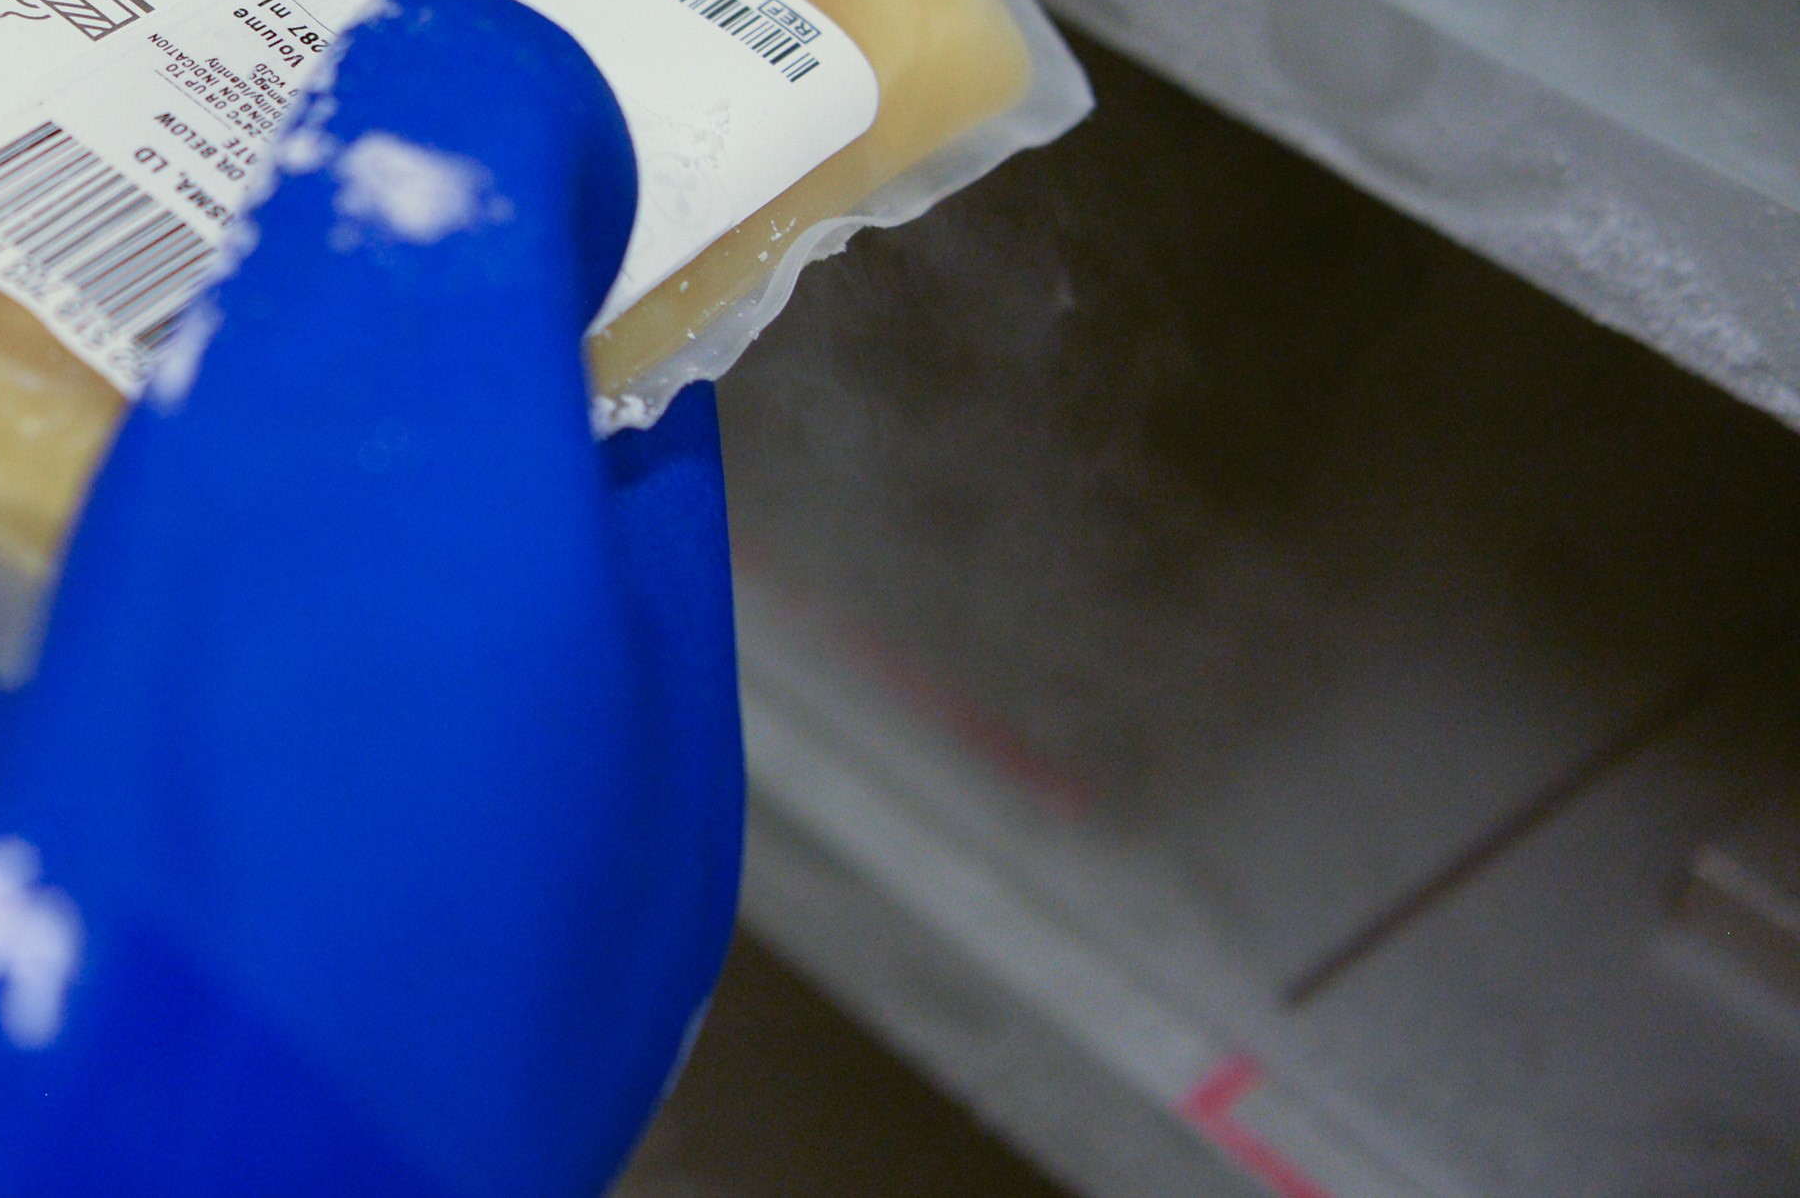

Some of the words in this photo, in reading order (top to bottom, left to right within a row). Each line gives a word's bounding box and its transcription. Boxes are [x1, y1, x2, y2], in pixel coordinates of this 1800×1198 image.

[765, 5, 815, 39] REF
[233, 7, 304, 68] Volume
[288, 25, 331, 53] 287
[148, 33, 220, 87] INDICATION
[166, 63, 185, 79] TO
[185, 79, 207, 95] UP
[255, 63, 286, 88] vCJD
[205, 94, 227, 110] OR
[219, 87, 240, 103] ON
[154, 111, 218, 159] BELOW
[134, 146, 169, 174] LD
[223, 138, 258, 165] ATE
[216, 154, 245, 182] OR
